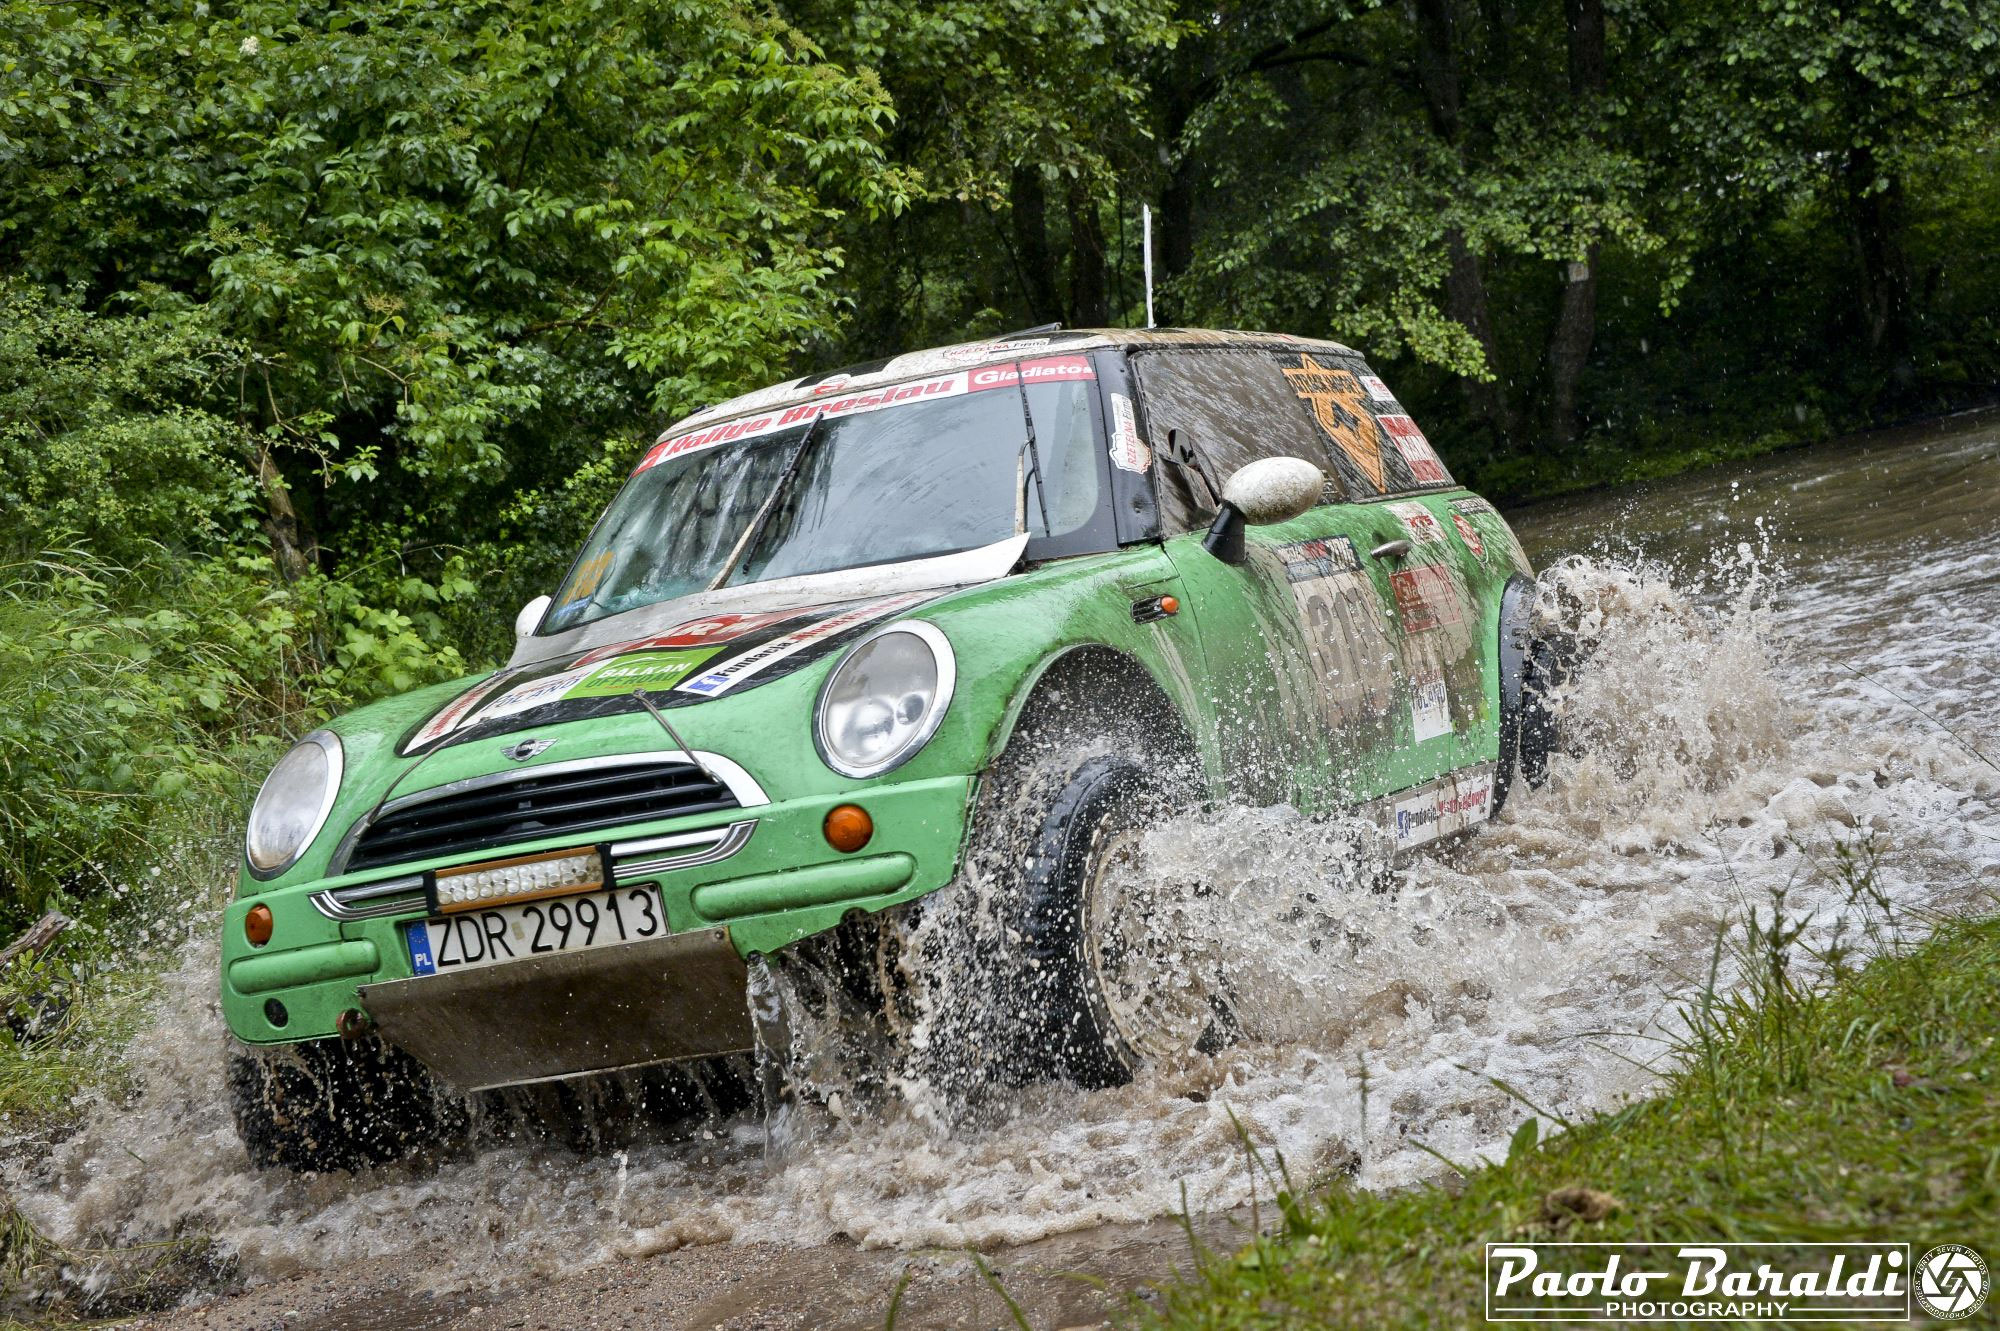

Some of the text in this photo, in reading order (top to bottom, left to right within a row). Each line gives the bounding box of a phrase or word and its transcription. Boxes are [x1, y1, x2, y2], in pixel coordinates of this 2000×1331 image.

[665, 417, 773, 457] Rallye
[776, 379, 956, 426] Breslau
[596, 662, 693, 679] BALKAN
[428, 889, 659, 967] ZDR 29913
[414, 952, 432, 967] PL
